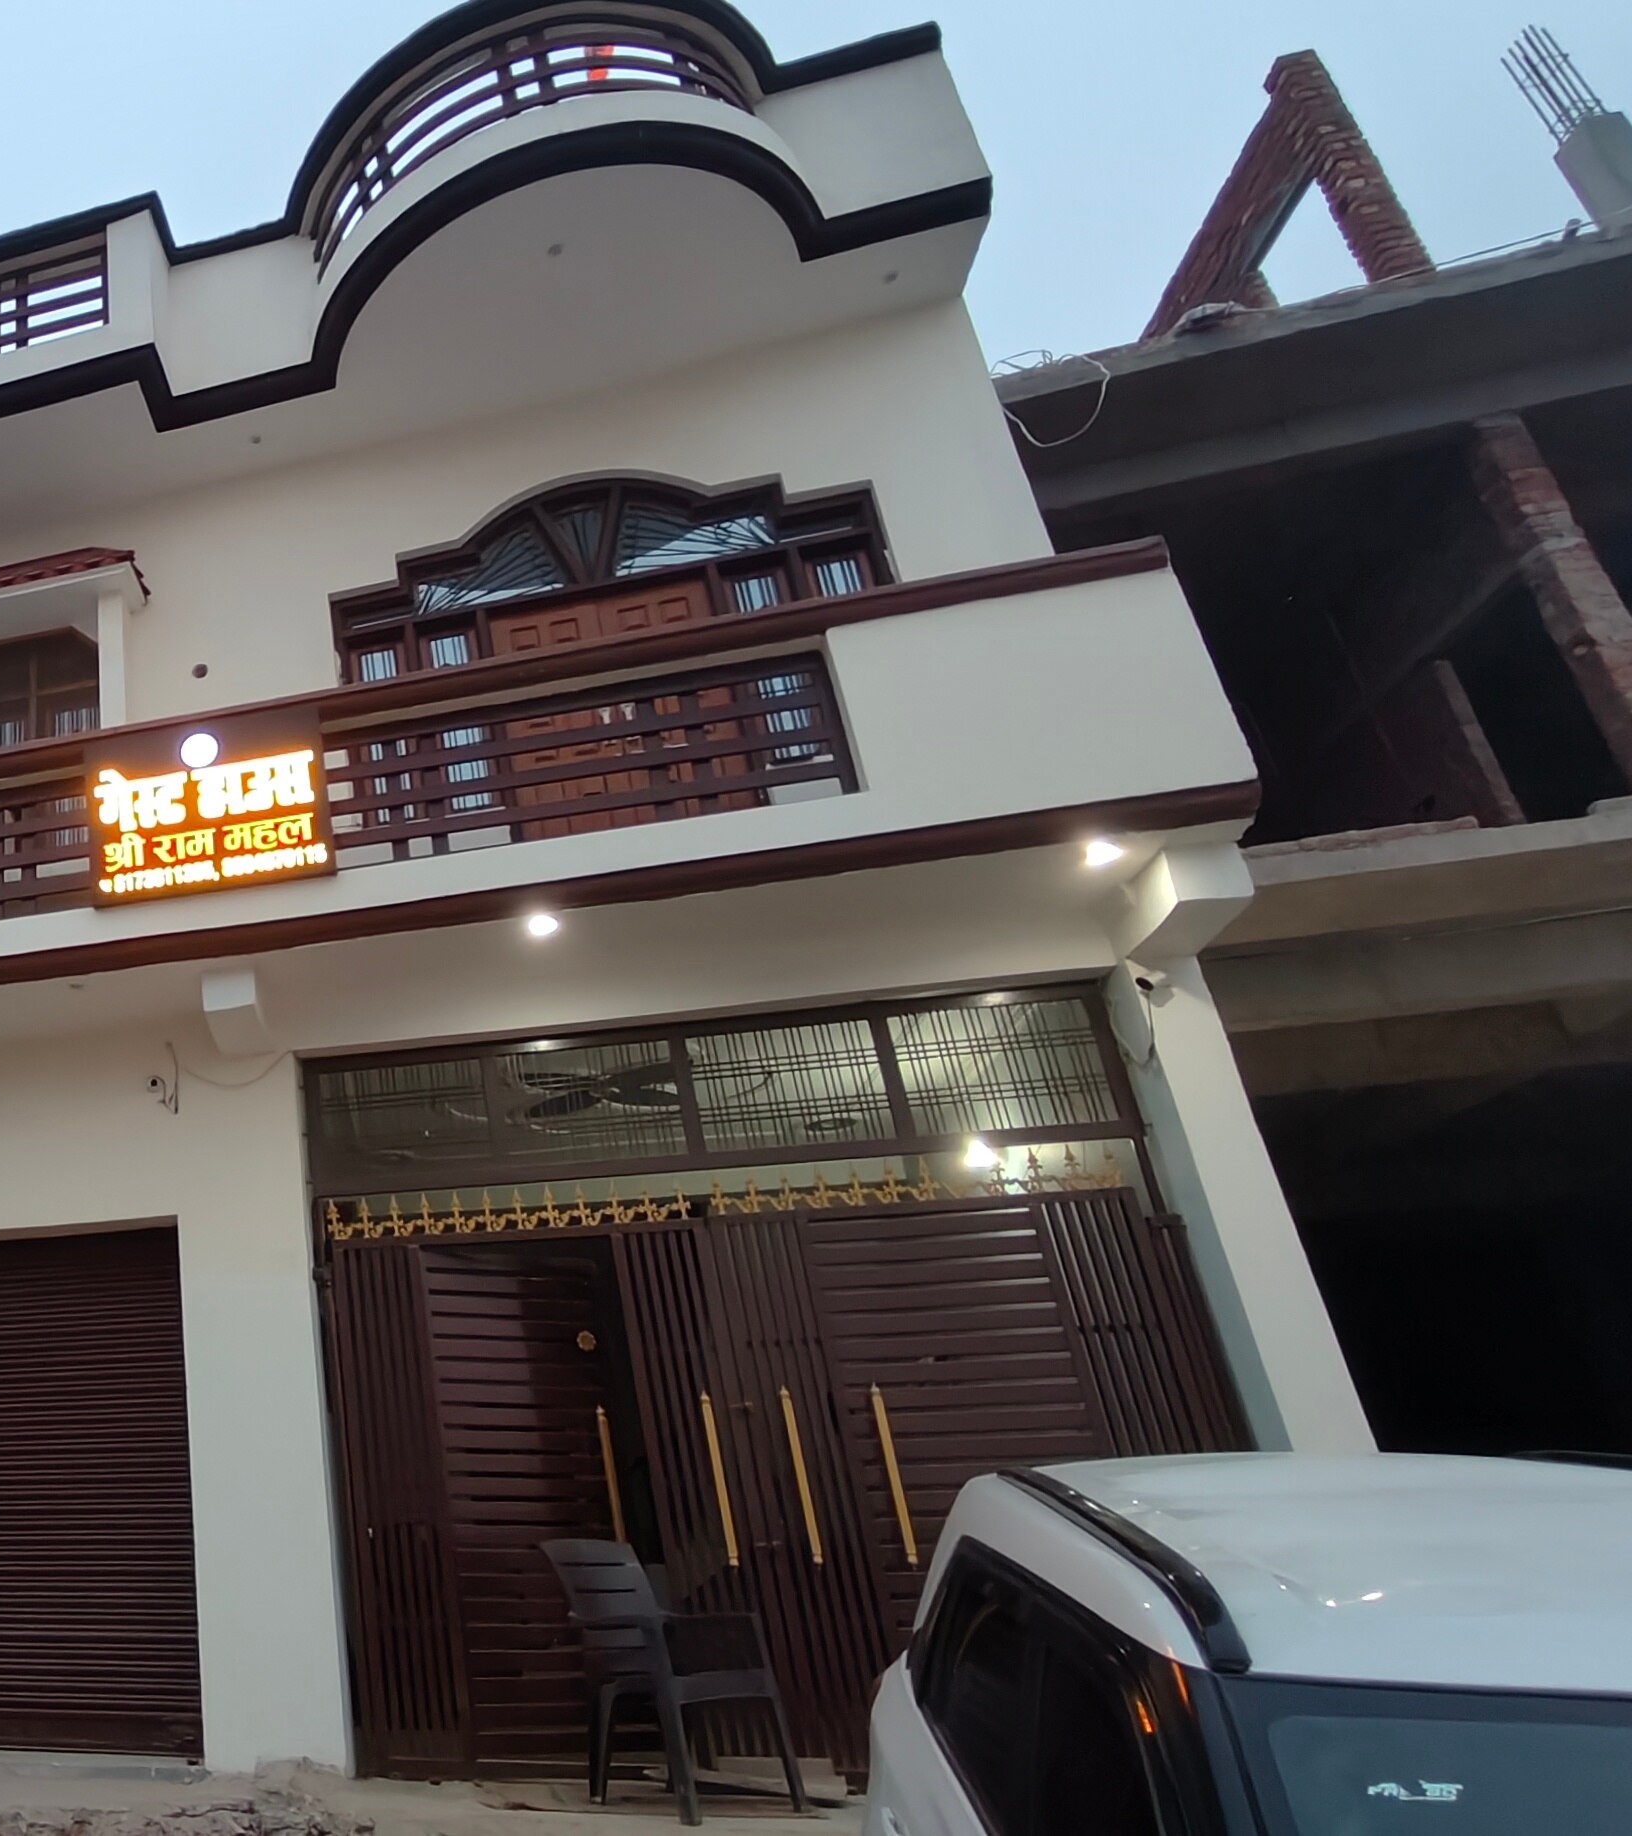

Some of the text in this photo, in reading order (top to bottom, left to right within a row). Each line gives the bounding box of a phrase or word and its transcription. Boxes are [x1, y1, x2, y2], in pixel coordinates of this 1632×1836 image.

[94, 749, 315, 832] गेस्ट हाउस
[103, 812, 313, 873] श्री राम महल
